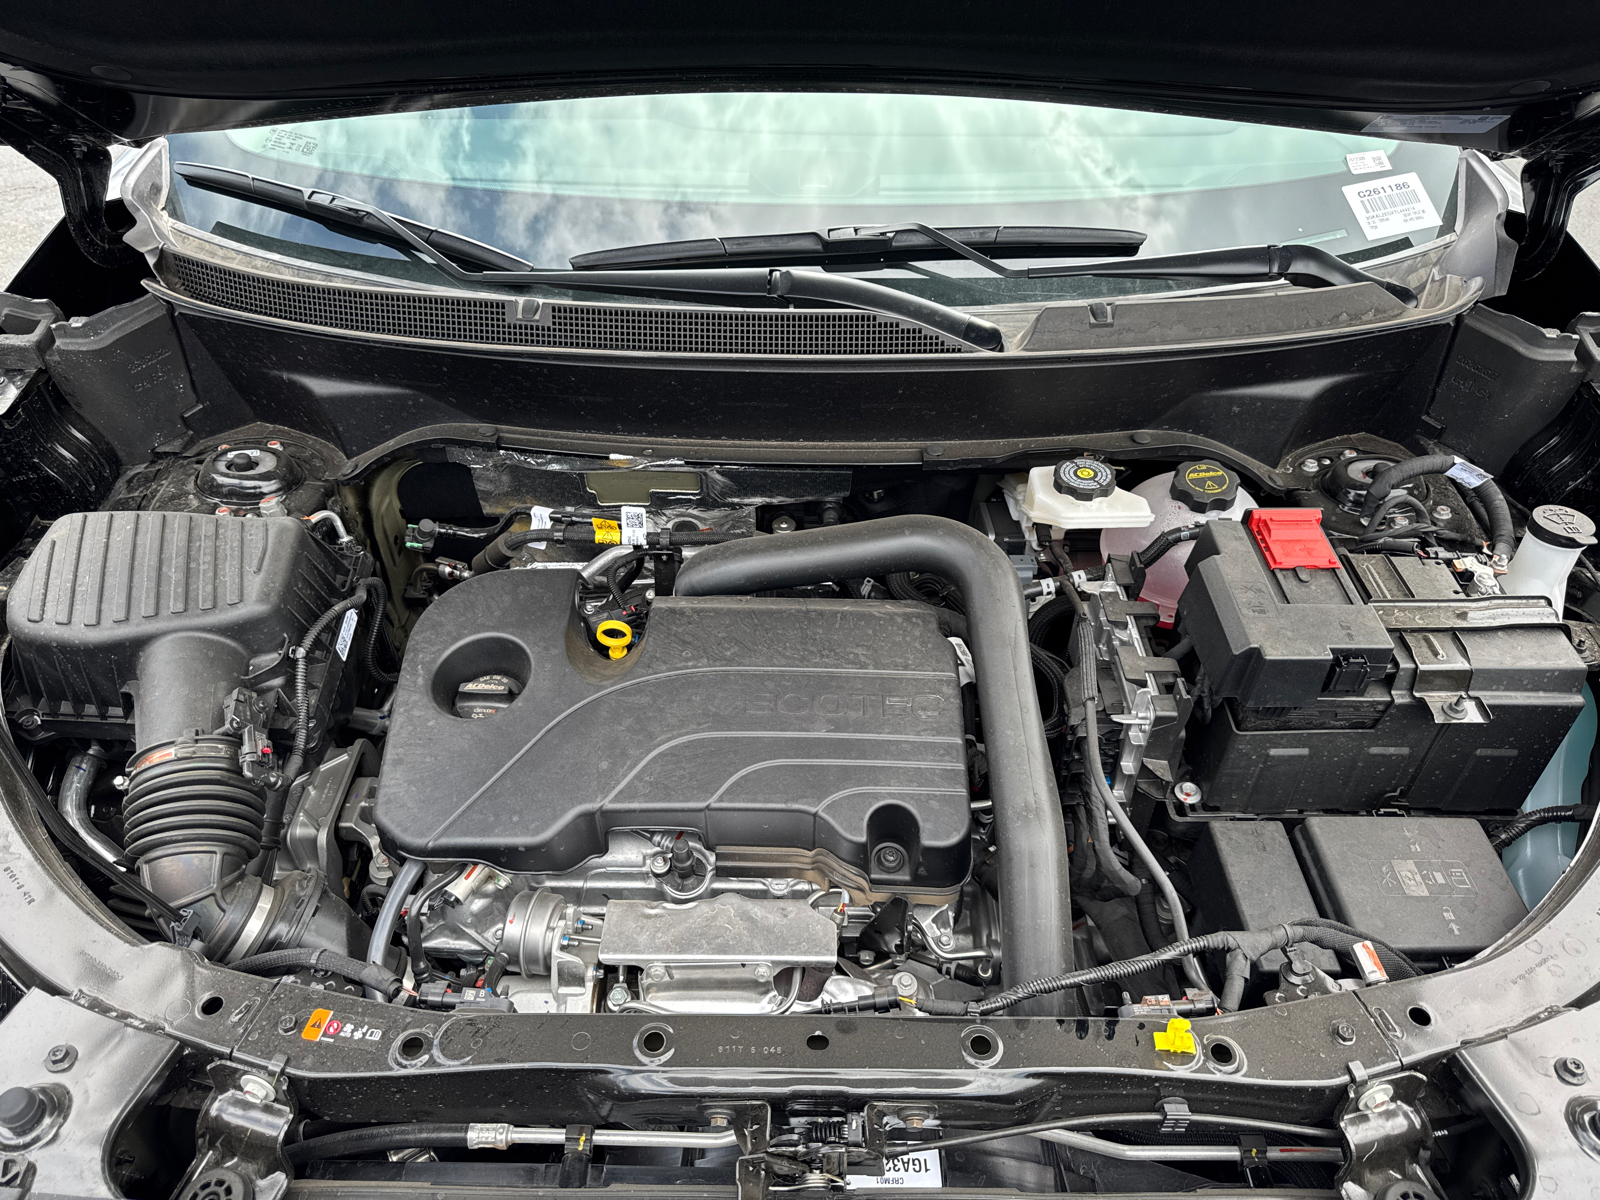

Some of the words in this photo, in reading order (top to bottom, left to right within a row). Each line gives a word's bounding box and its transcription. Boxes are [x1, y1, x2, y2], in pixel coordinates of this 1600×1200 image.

[1357, 181, 1410, 199] G261186
[1187, 471, 1223, 479] ACDelco
[745, 692, 946, 720] ECOTEC
[479, 989, 486, 998] B
[876, 1177, 904, 1185] CRFM01
